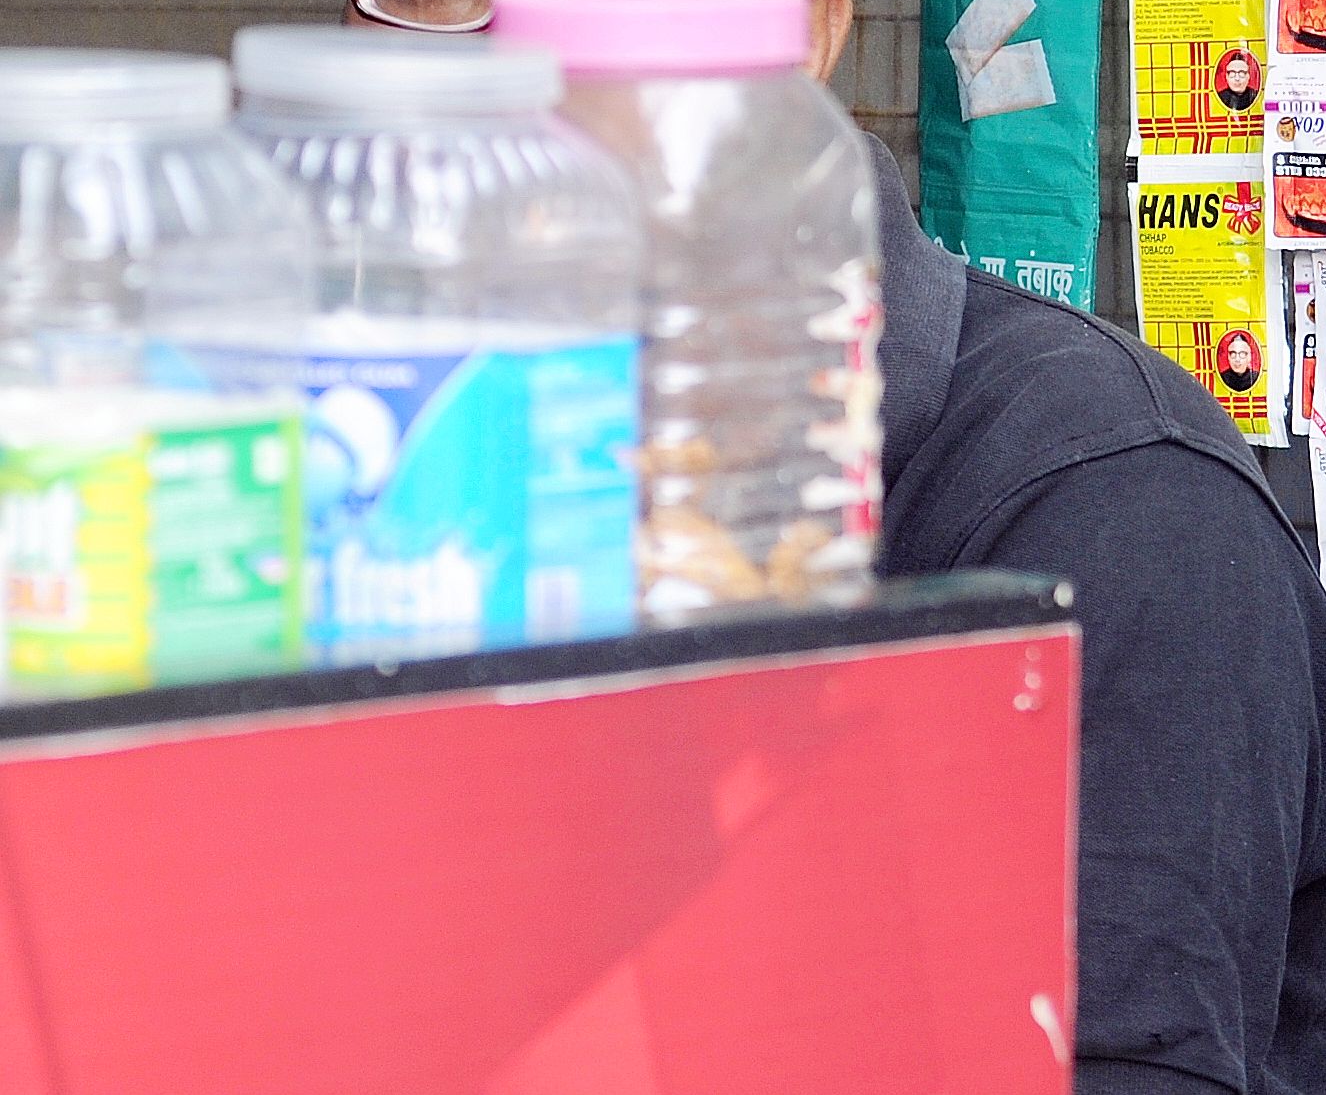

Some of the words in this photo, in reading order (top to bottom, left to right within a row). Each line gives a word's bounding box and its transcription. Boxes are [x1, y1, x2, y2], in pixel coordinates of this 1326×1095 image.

[1138, 193, 1220, 229] HANS
[1139, 233, 1167, 243] CHHAP
[1140, 246, 1175, 255] TOBACCO
